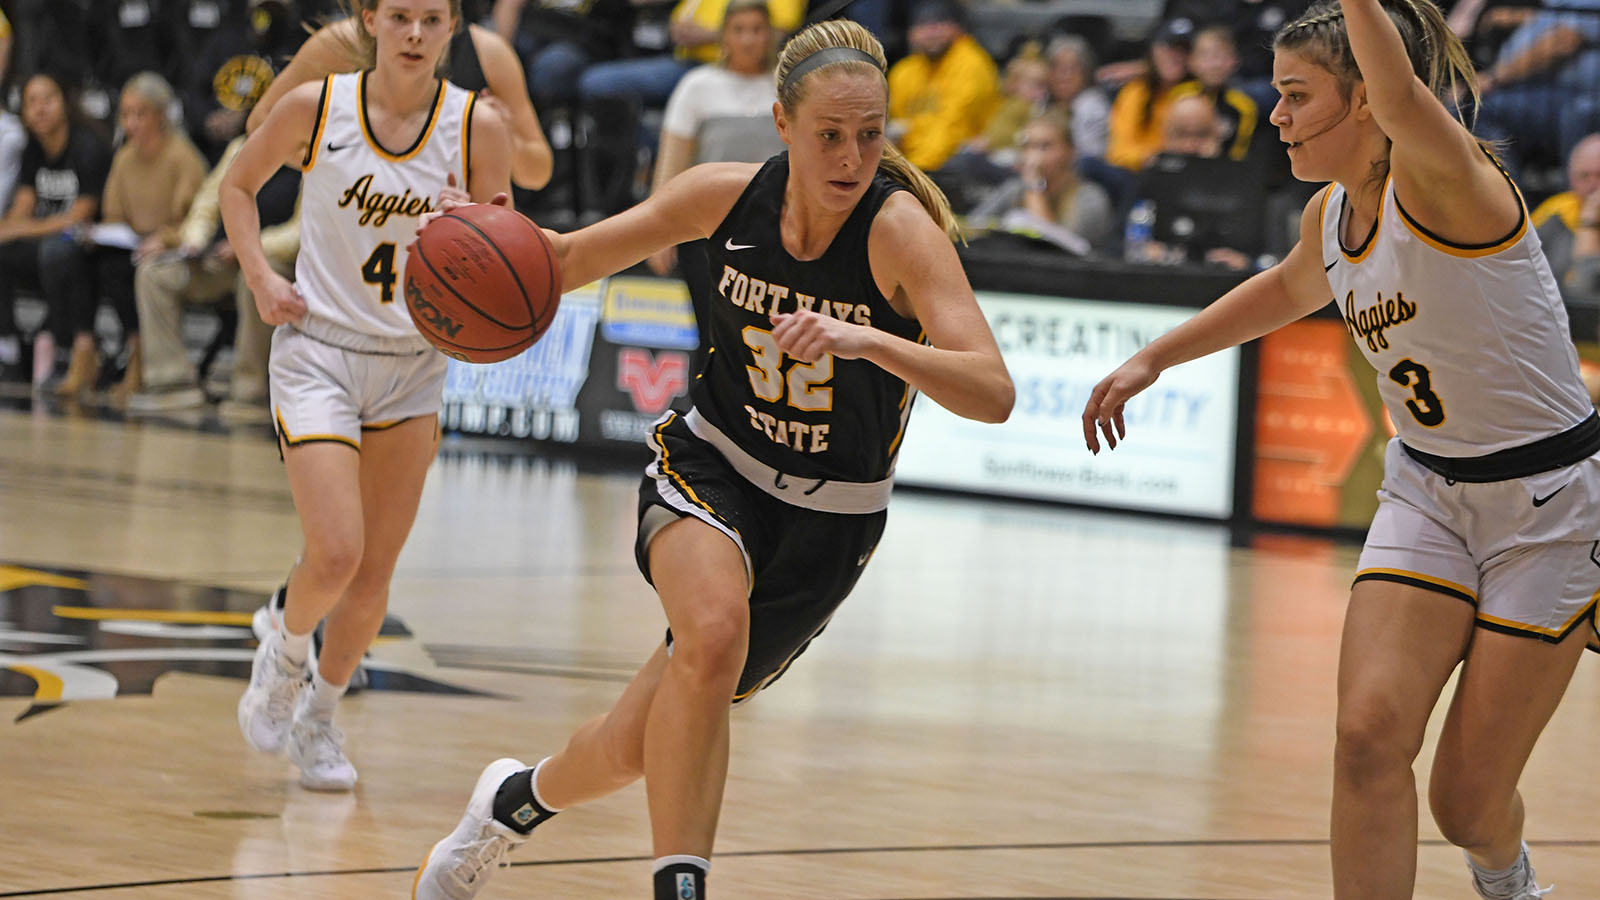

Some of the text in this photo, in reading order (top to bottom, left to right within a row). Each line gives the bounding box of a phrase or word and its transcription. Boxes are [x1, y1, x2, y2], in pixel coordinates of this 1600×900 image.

[338, 174, 435, 227] Aggies
[361, 241, 398, 303] 4
[718, 264, 789, 319] FORT
[795, 291, 872, 328] HAYS
[404, 275, 465, 339] NCAA
[994, 311, 1170, 358] CREATIN
[1346, 289, 1418, 354] Aggies
[741, 325, 834, 412] 32
[1389, 357, 1447, 429] 3
[744, 404, 830, 454] STATE
